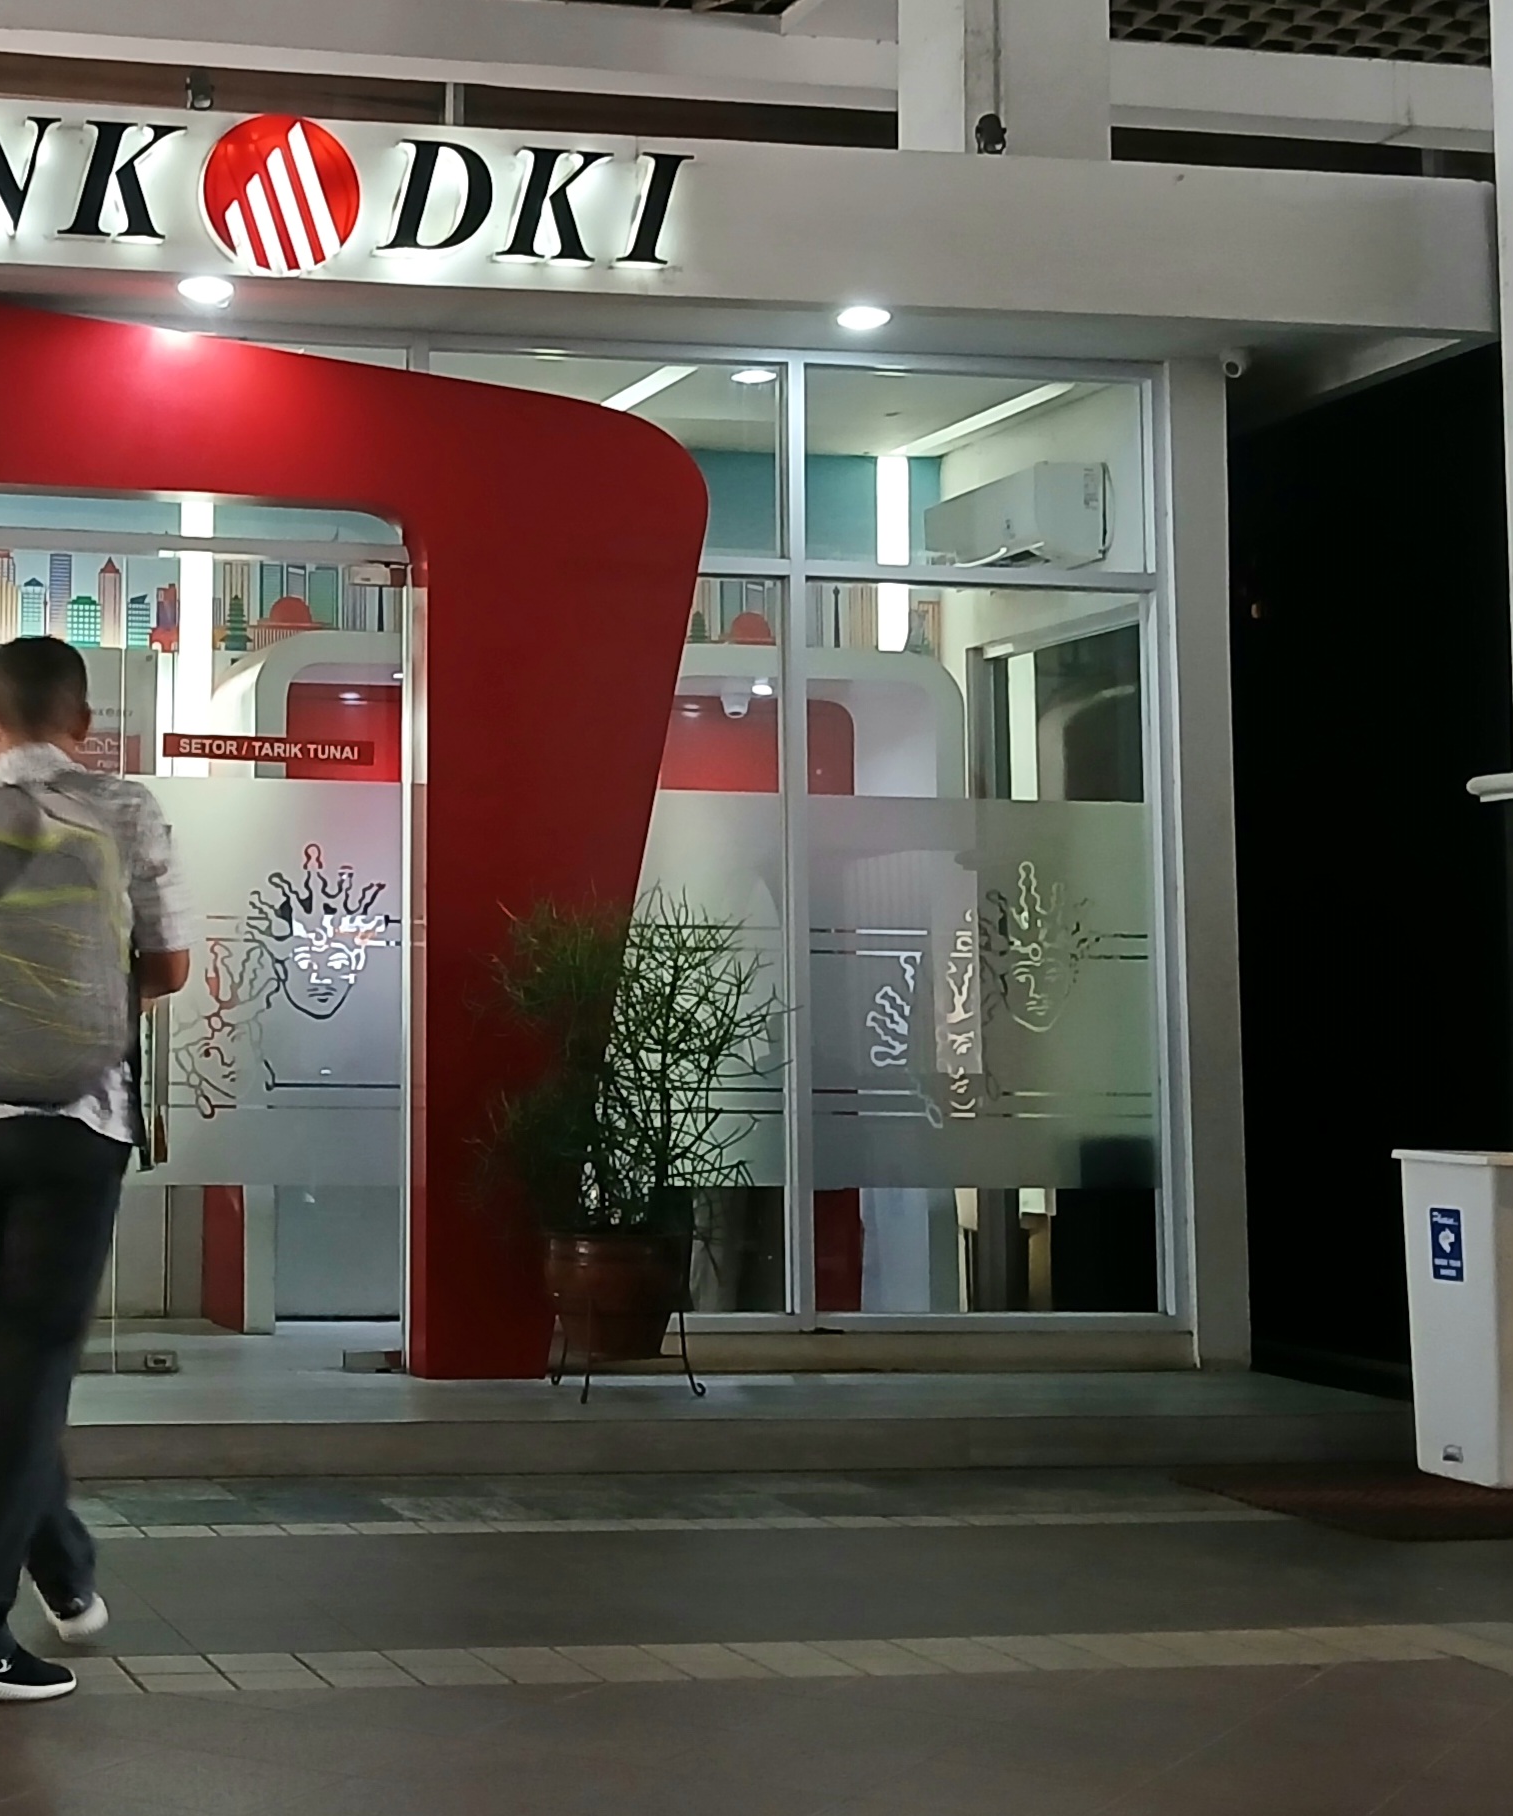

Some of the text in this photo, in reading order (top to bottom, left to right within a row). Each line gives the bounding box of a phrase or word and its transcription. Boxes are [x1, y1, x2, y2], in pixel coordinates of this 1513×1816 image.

[376, 139, 695, 265] DKI
[179, 739, 237, 756] SETOR
[252, 741, 302, 759] TARIK
[307, 744, 358, 760] TUNAI
